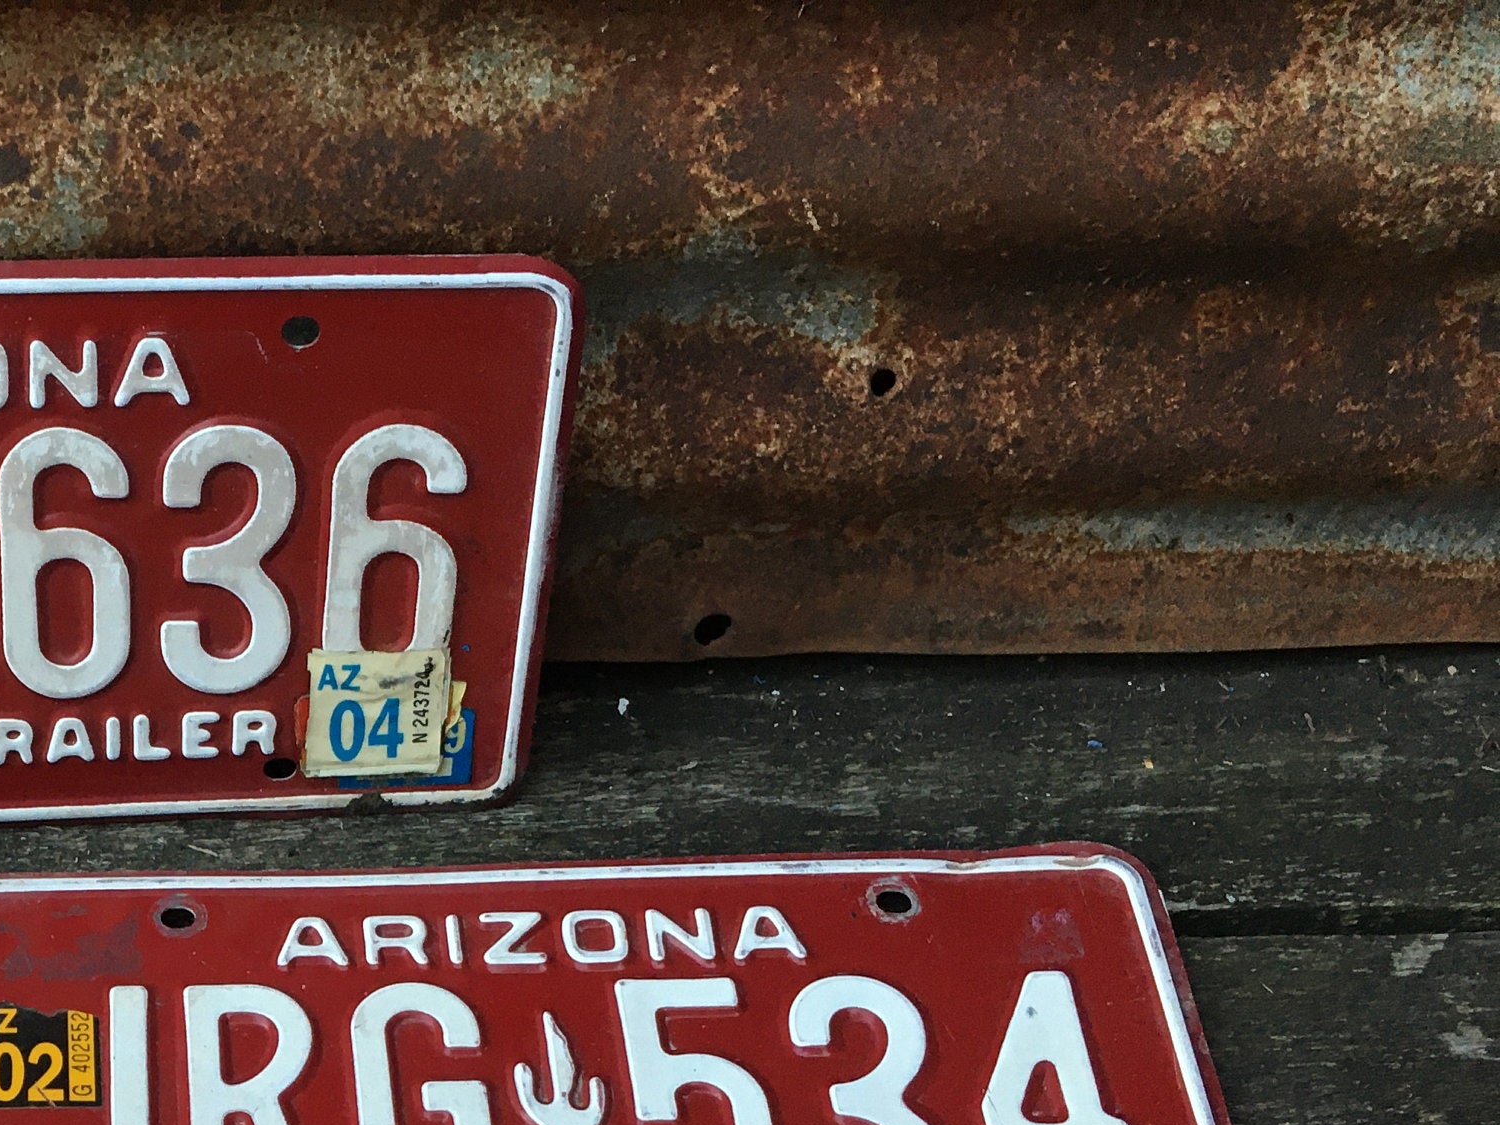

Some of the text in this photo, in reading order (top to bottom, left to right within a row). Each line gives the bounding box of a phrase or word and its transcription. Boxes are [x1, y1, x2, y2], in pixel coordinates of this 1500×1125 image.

[317, 664, 361, 691] AZ
[329, 697, 404, 762] 04
[278, 906, 807, 966] ARIZONA
[71, 1012, 91, 1073] 402552
